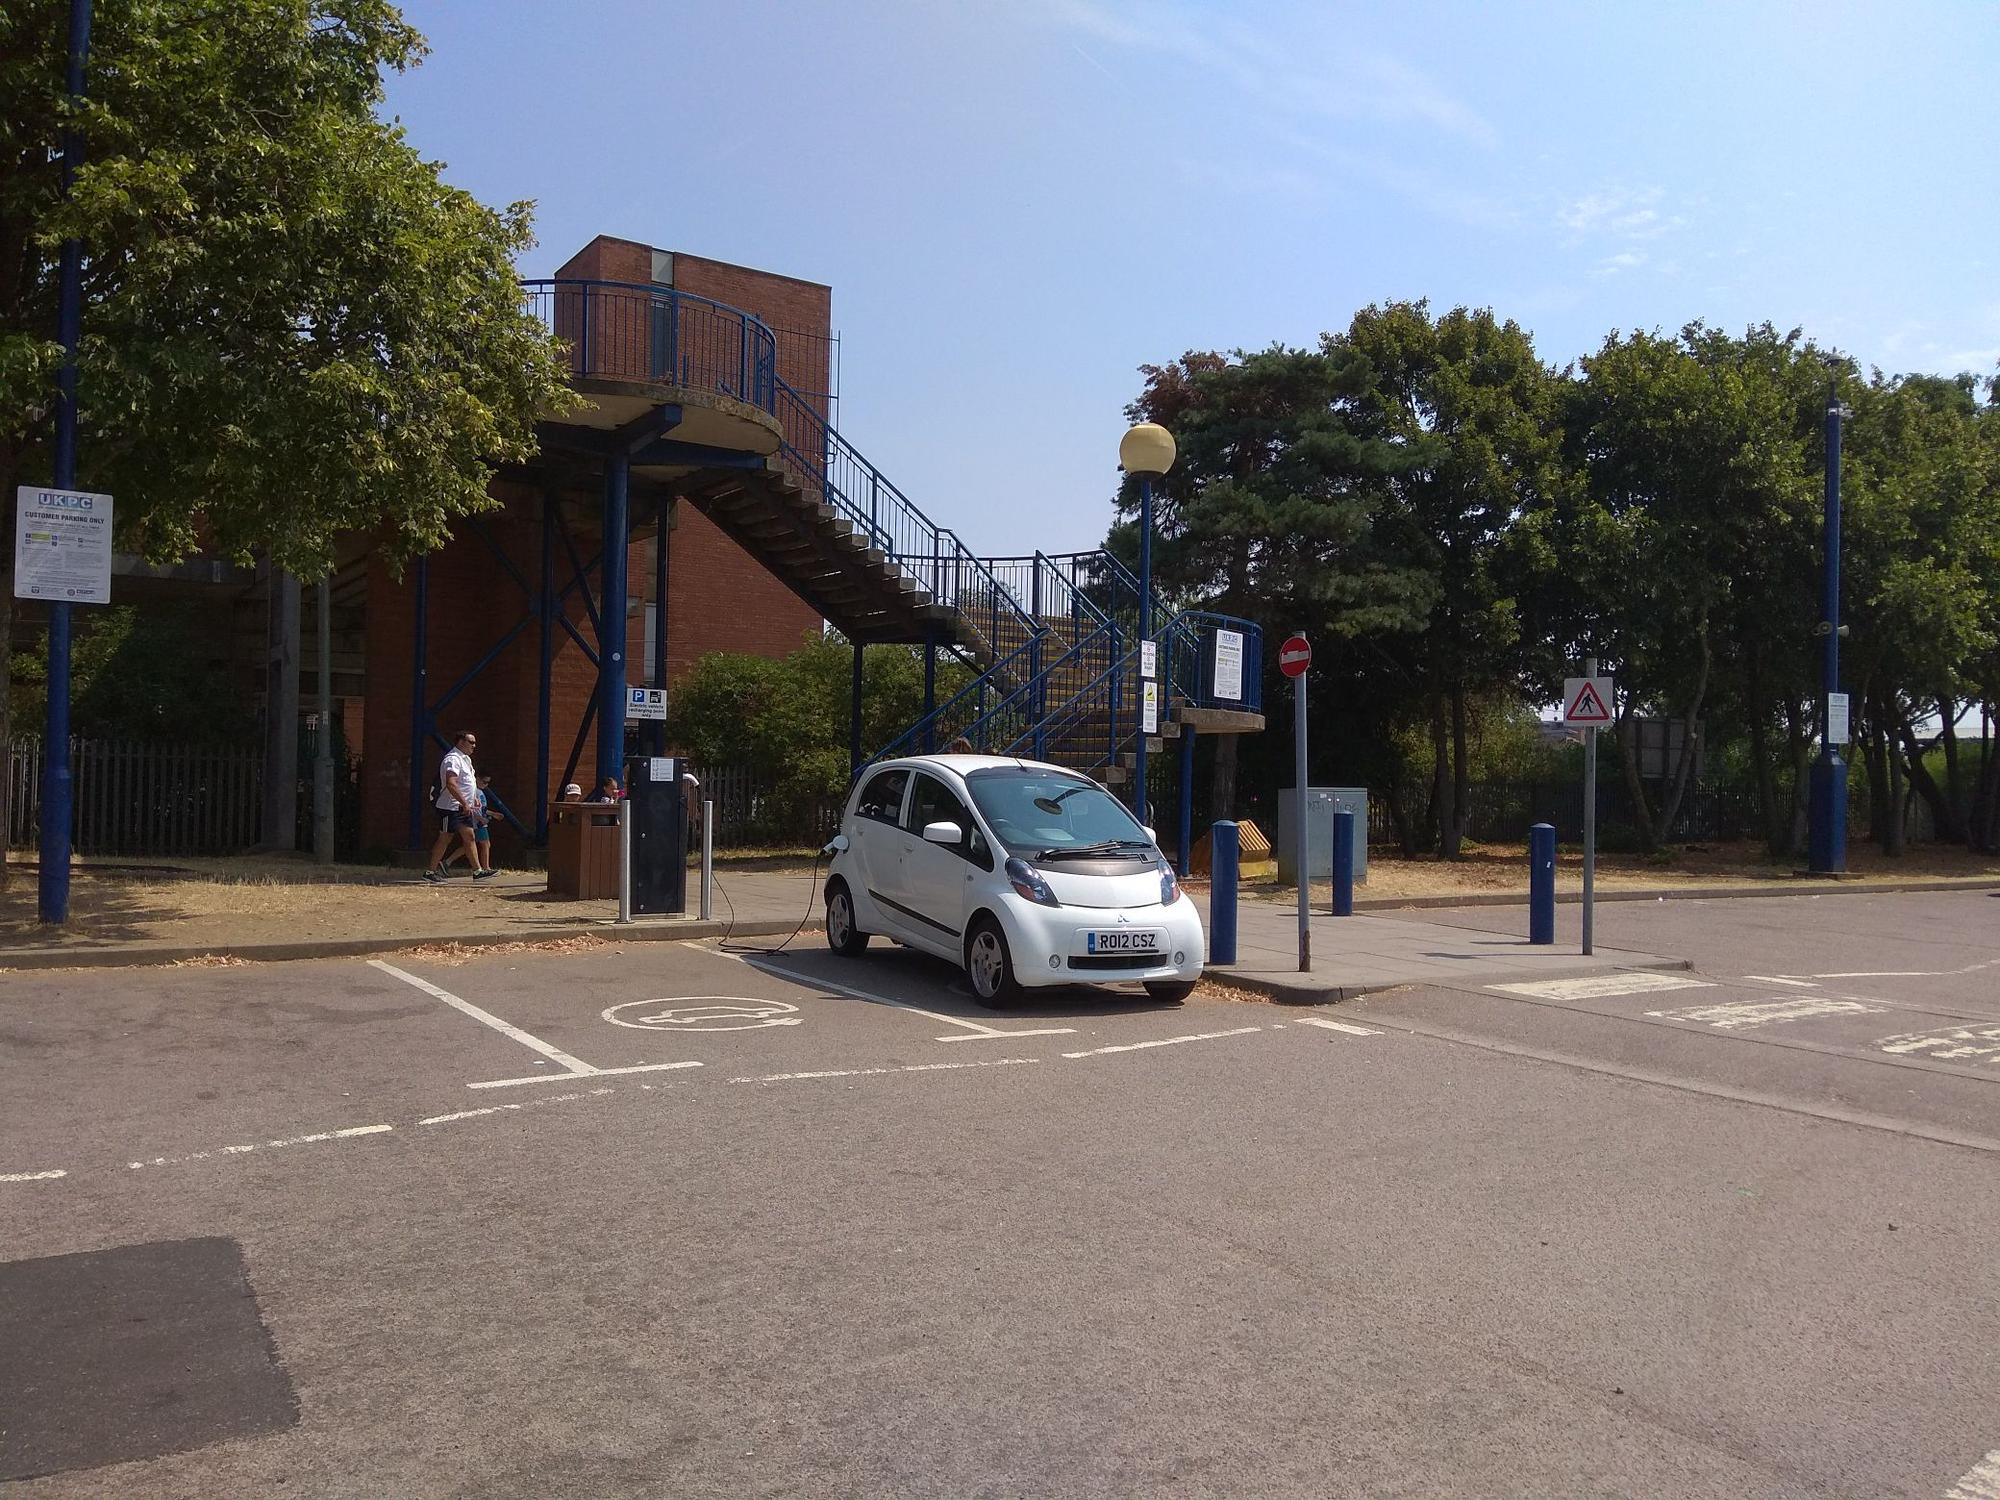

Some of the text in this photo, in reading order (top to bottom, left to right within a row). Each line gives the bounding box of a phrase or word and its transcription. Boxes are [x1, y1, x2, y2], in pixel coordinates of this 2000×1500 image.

[39, 493, 92, 509] UKPC
[25, 511, 105, 525] CUSTOMER PARKING ONLY
[634, 691, 642, 701] P
[1100, 934, 1156, 948] RO12 CSZ
